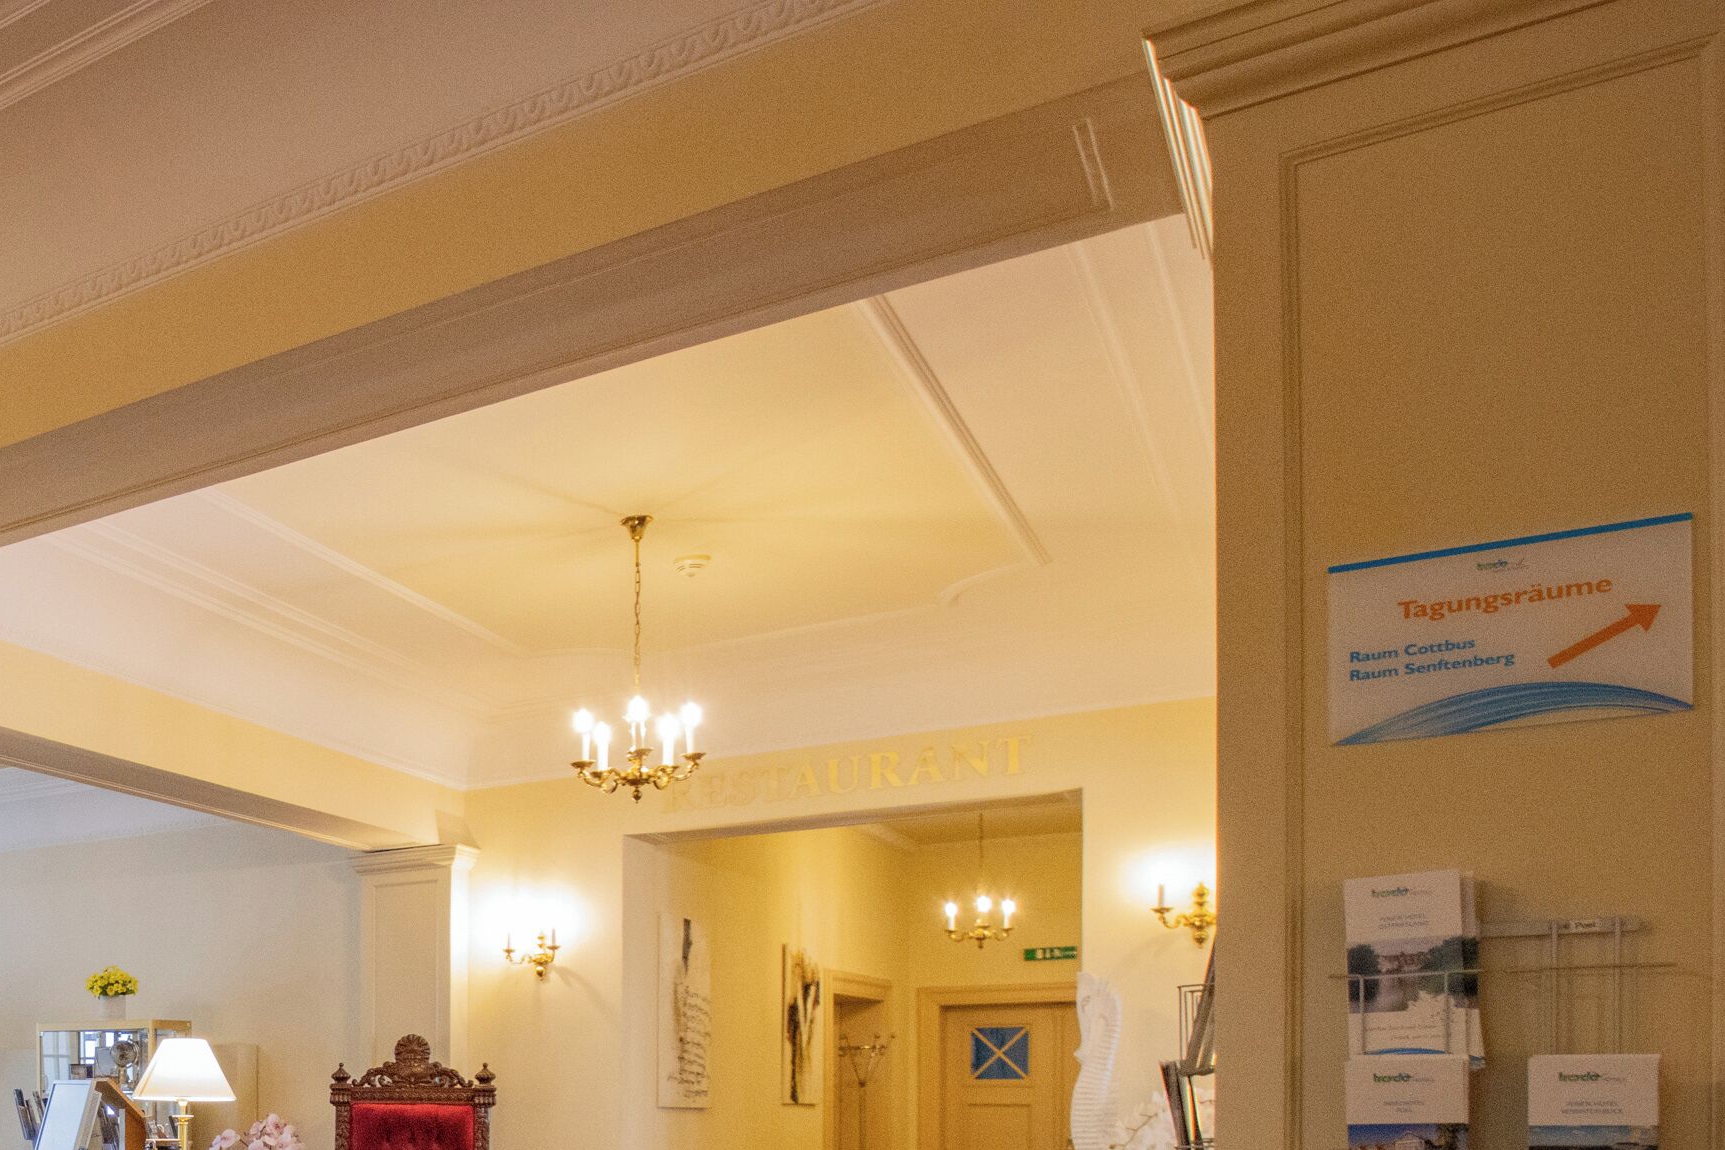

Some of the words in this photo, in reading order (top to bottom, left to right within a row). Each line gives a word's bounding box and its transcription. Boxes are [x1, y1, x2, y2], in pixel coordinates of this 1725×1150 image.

[1398, 578, 1612, 622] Tagungsräume
[1349, 648, 1399, 664] Raum
[1404, 638, 1475, 657] Cottbus
[1349, 666, 1399, 682] Raum
[1404, 653, 1515, 676] Senftenberg
[663, 735, 1034, 815] RESTAURANT
